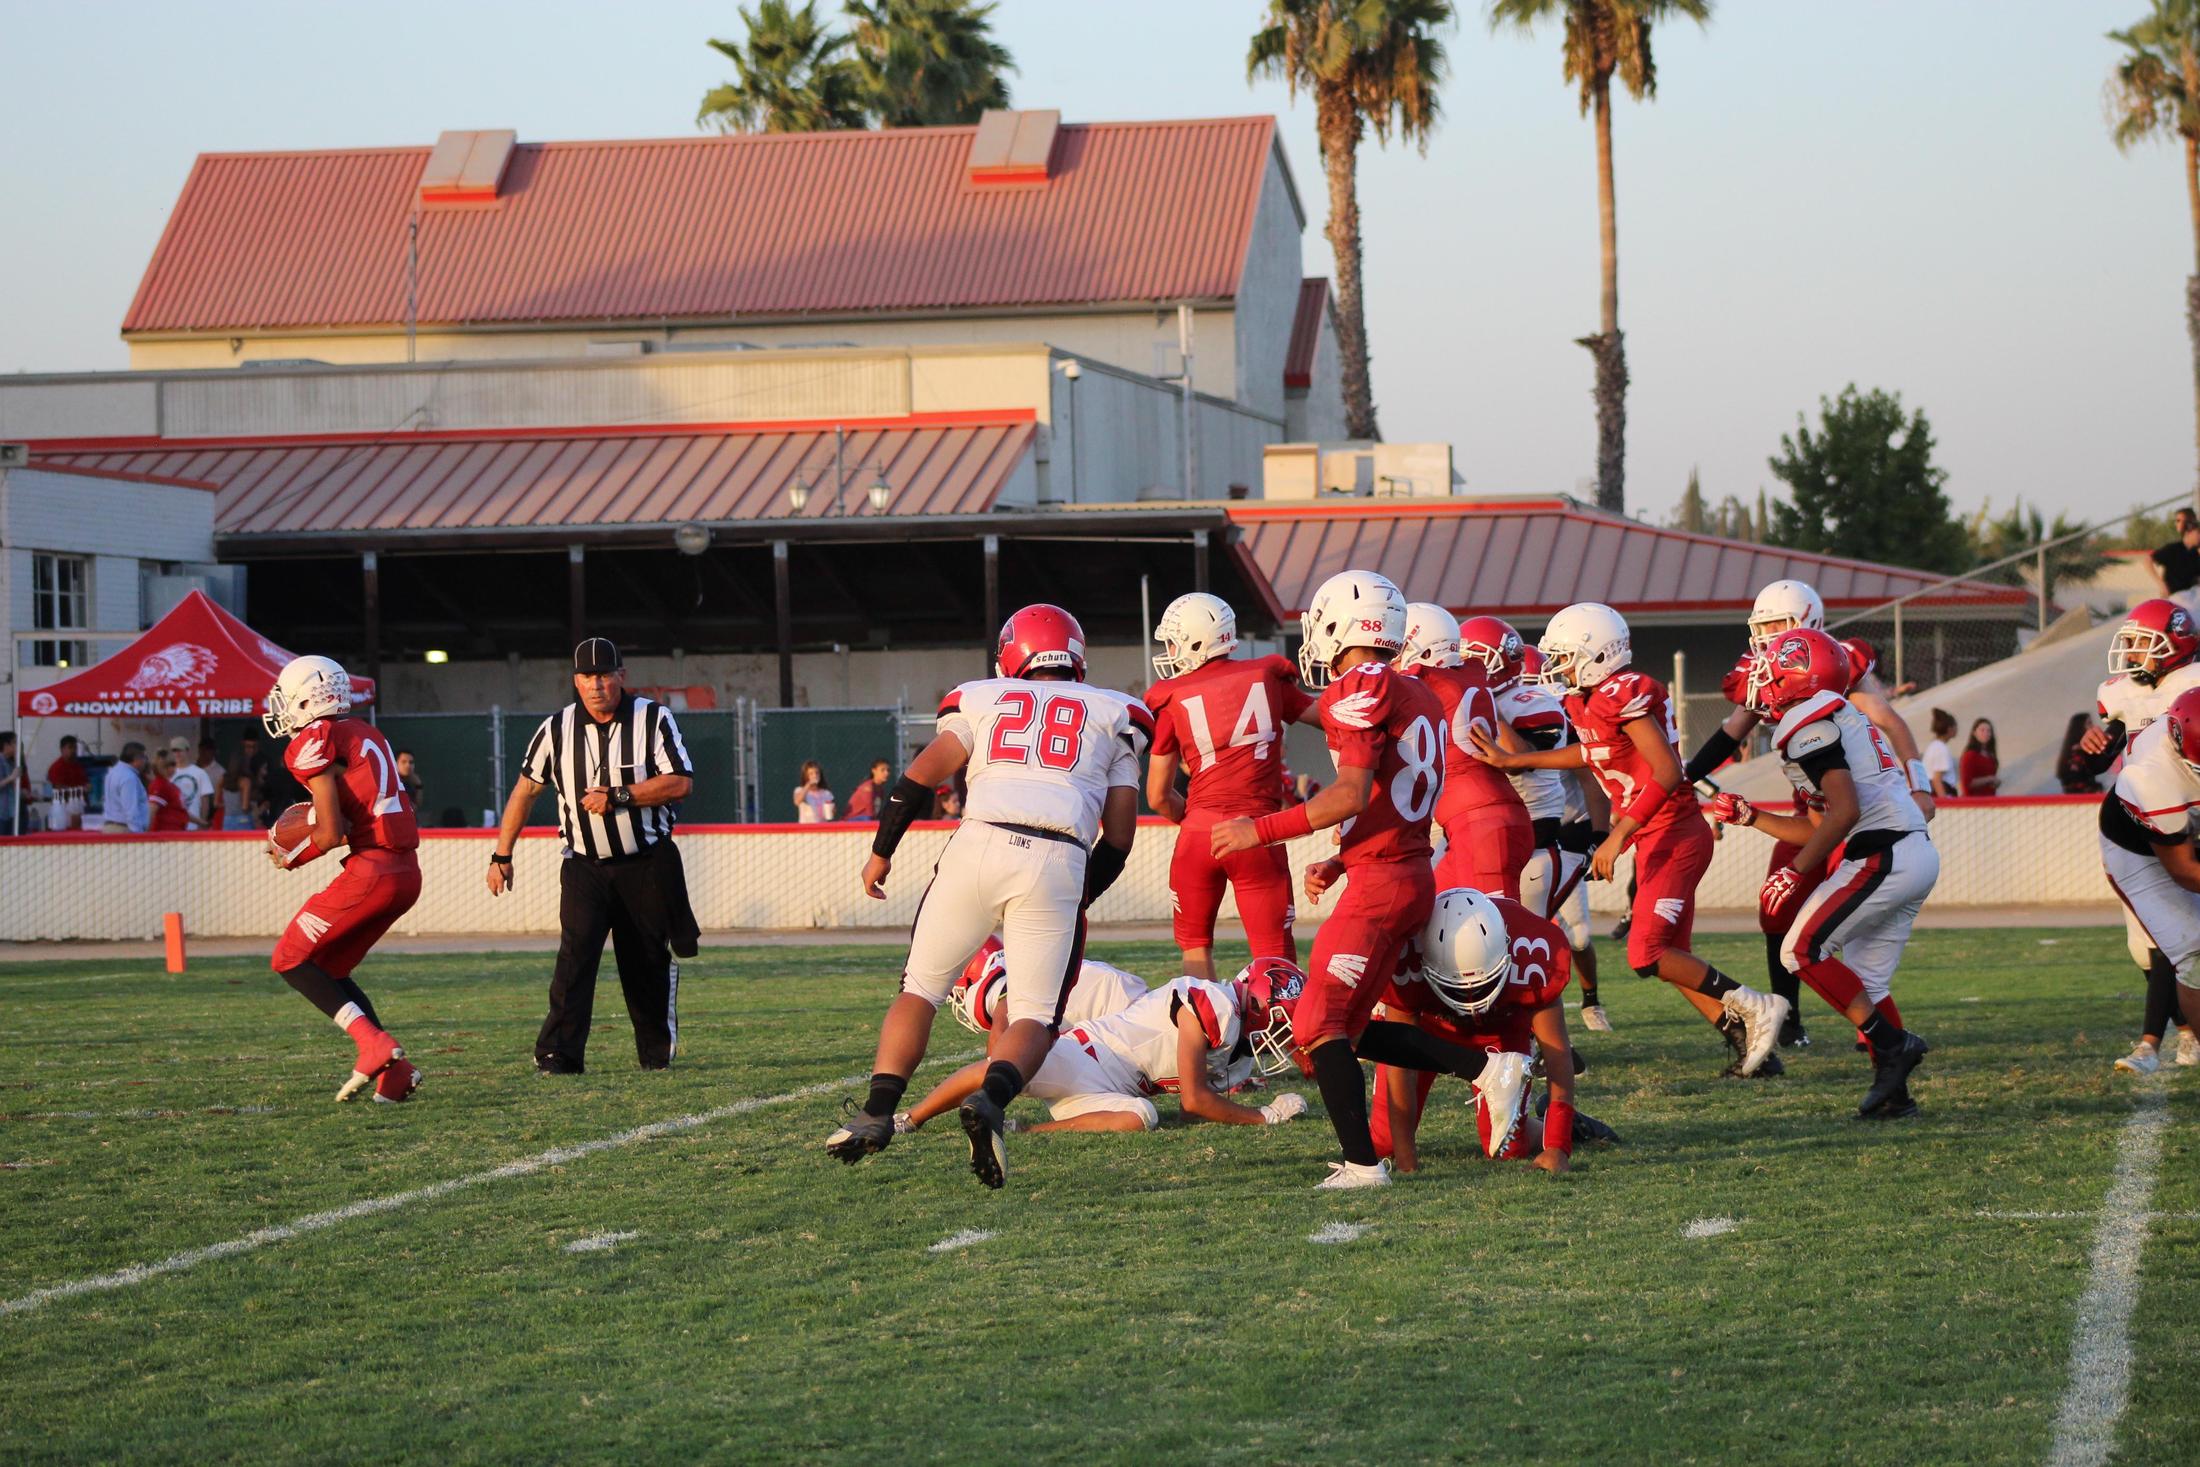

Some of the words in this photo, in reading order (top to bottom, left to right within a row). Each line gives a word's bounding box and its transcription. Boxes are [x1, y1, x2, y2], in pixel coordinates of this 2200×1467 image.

[1361, 619, 1382, 633] 88
[64, 699, 191, 715] CHOWCHILLA
[198, 699, 254, 714] TRIBE
[987, 690, 1089, 772] 28
[1179, 682, 1277, 773] 14
[1008, 834, 1032, 849] LIONS
[1508, 936, 1551, 988] 53
